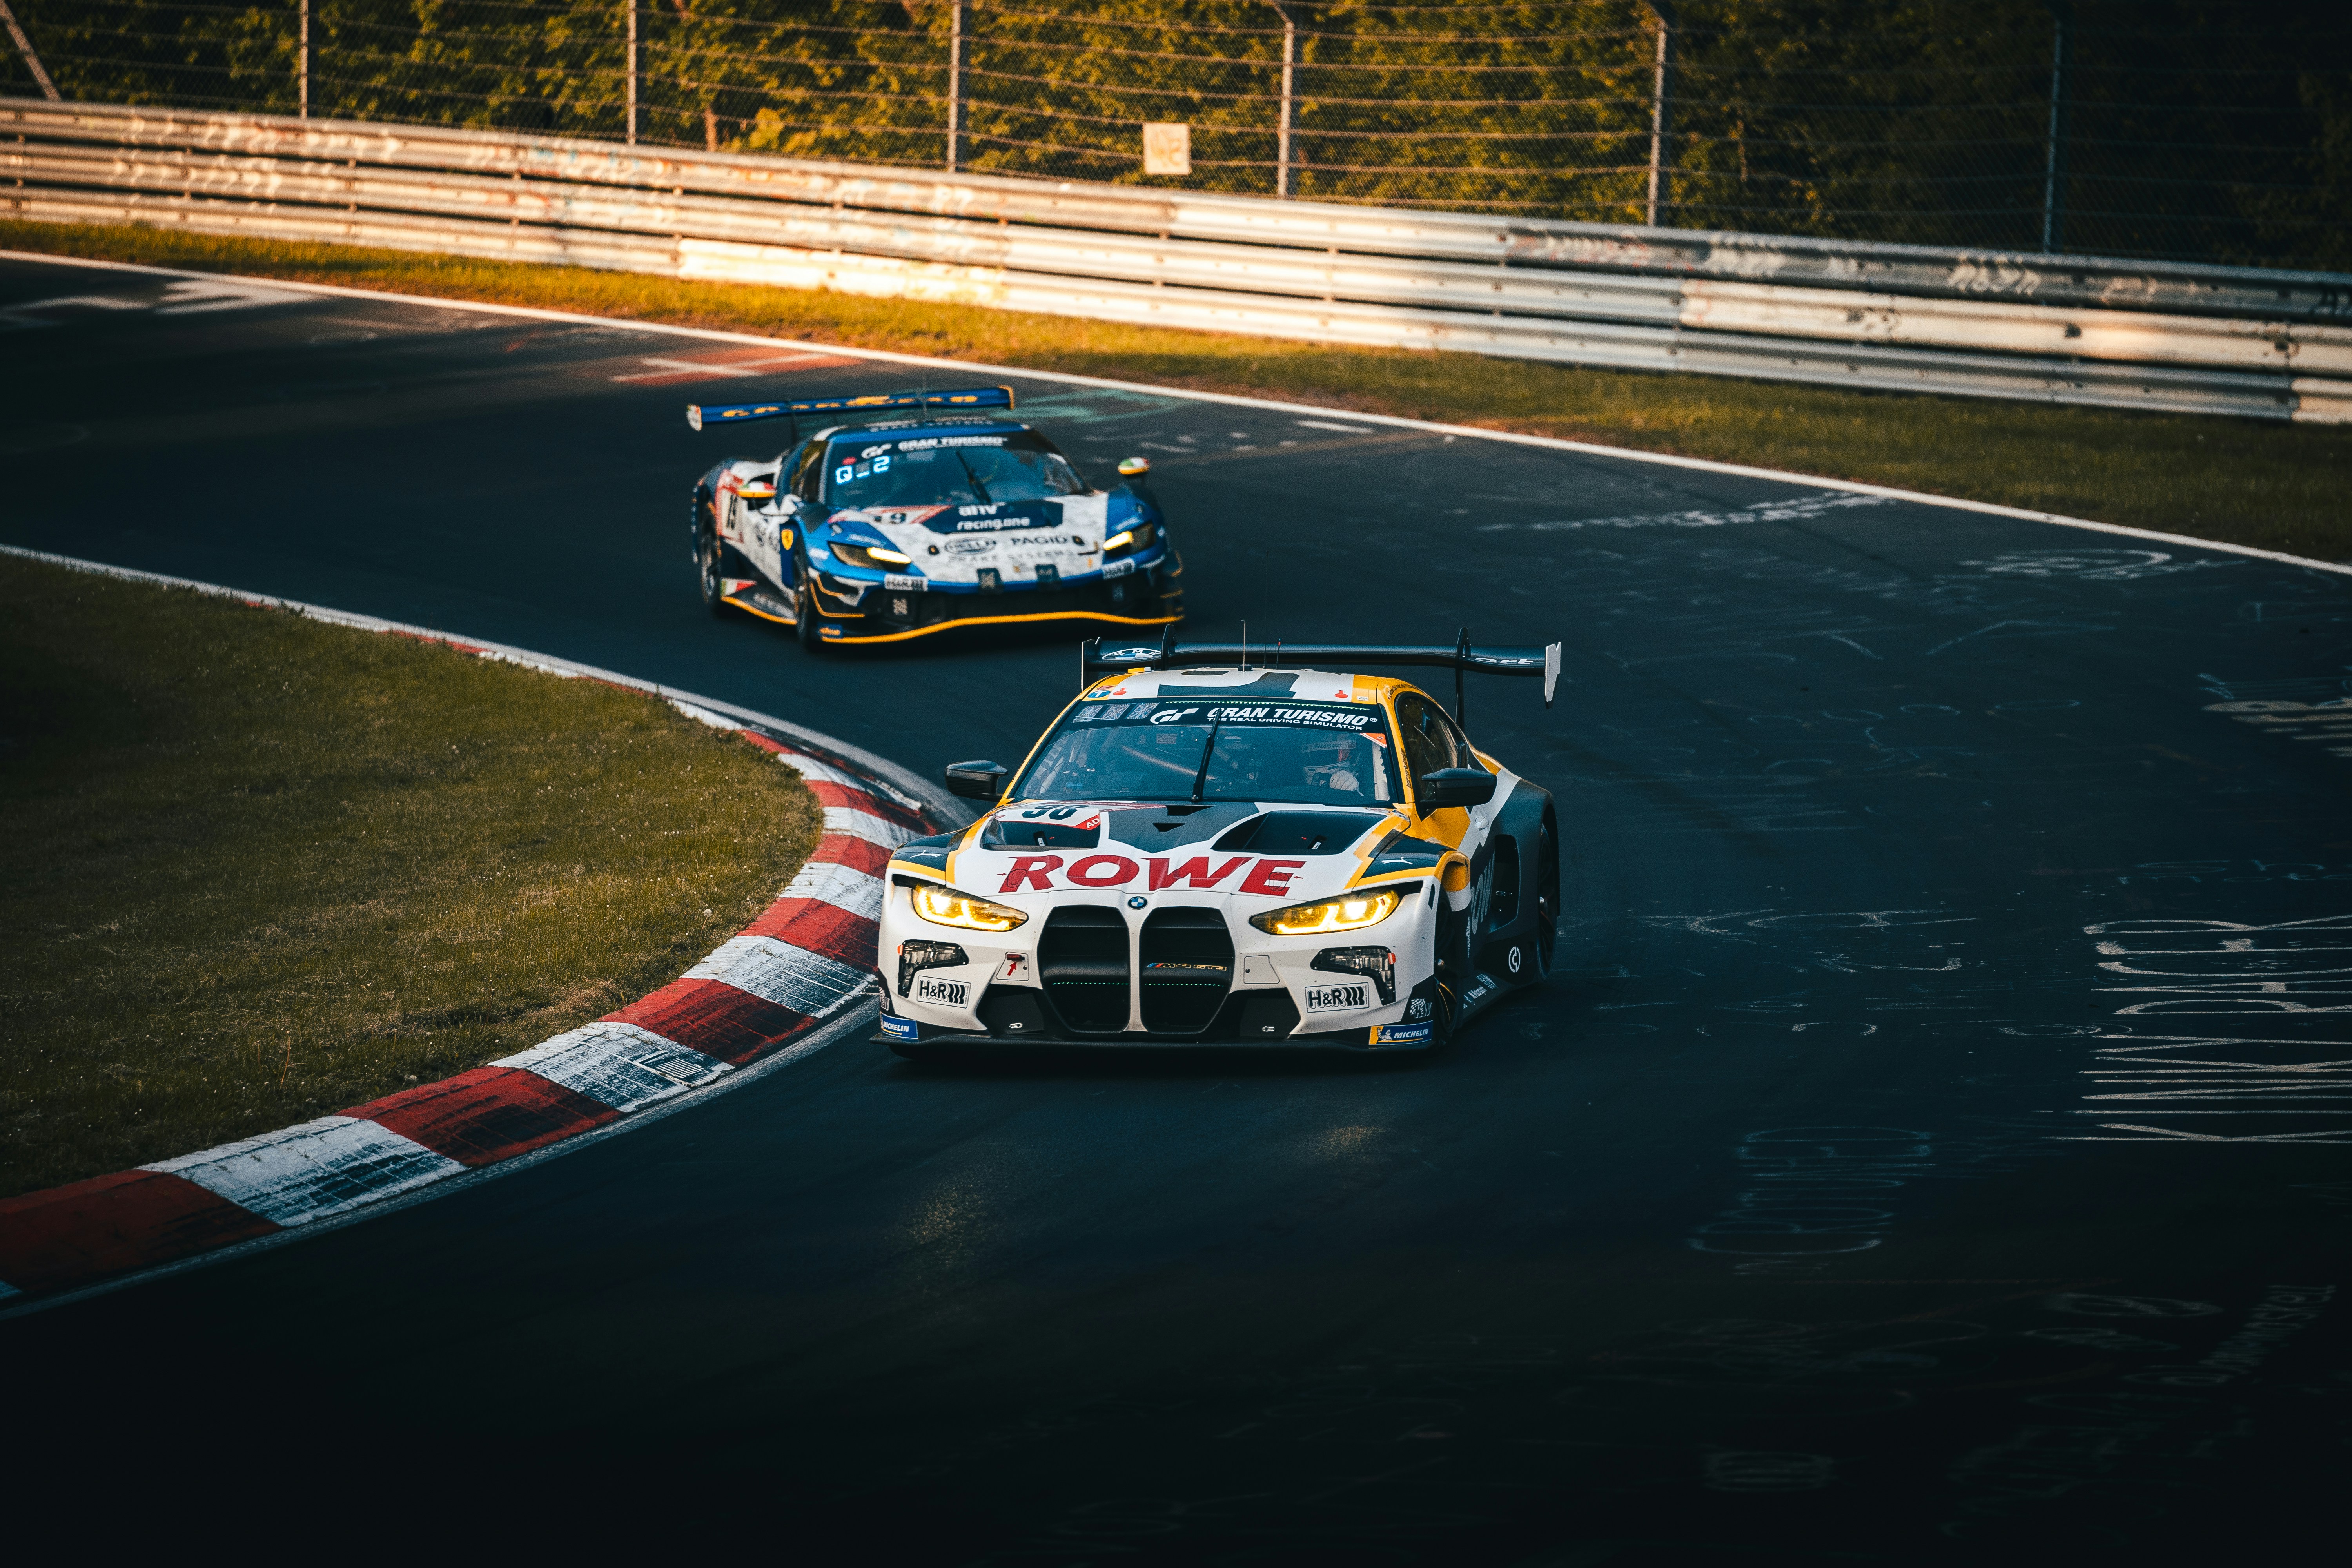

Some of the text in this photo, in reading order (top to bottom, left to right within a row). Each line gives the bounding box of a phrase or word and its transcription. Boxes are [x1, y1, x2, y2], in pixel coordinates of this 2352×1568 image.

[898, 438, 938, 449] GRAN
[941, 436, 1004, 446] TURISMO
[957, 517, 1031, 530] racing.one
[1011, 536, 1068, 545] PAGID
[1207, 707, 1269, 718] GRAN
[1303, 720, 1363, 731] SIMULATOR
[998, 855, 1307, 897] ROWE
[919, 979, 948, 1002] H&R
[1307, 987, 1346, 1009] H&R
[1393, 1028, 1429, 1039] MICHELIN
